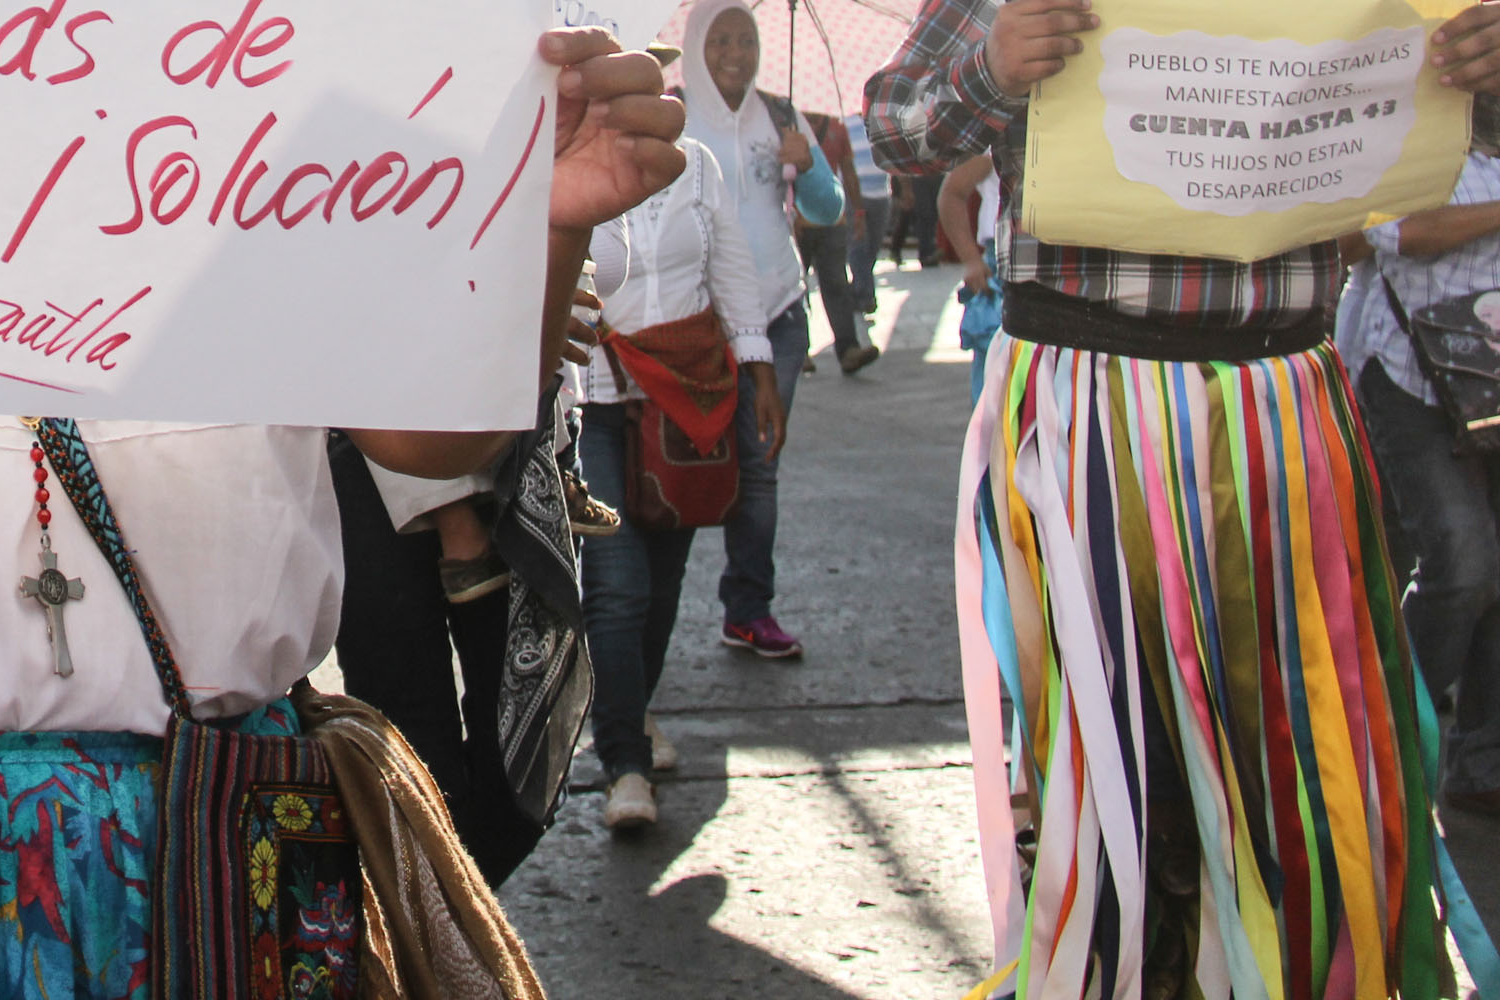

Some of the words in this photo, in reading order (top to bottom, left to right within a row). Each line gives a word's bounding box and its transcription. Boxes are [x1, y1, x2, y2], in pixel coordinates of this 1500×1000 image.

[1128, 53, 1208, 73] PUEBLO
[1214, 57, 1231, 74] SI
[1238, 58, 1262, 76] TE
[1268, 51, 1376, 78] MOLESTAN
[1379, 43, 1411, 64] LAS
[1129, 113, 1251, 139] CUENTA
[1260, 107, 1354, 140] HASTA
[1362, 98, 1397, 119] 43
[1165, 150, 1204, 168] TUS
[1211, 153, 1267, 171] HIJOS
[1274, 151, 1302, 169] NO
[1308, 137, 1363, 164] ESTAN
[1186, 169, 1343, 199] DESAPARECIDOS
